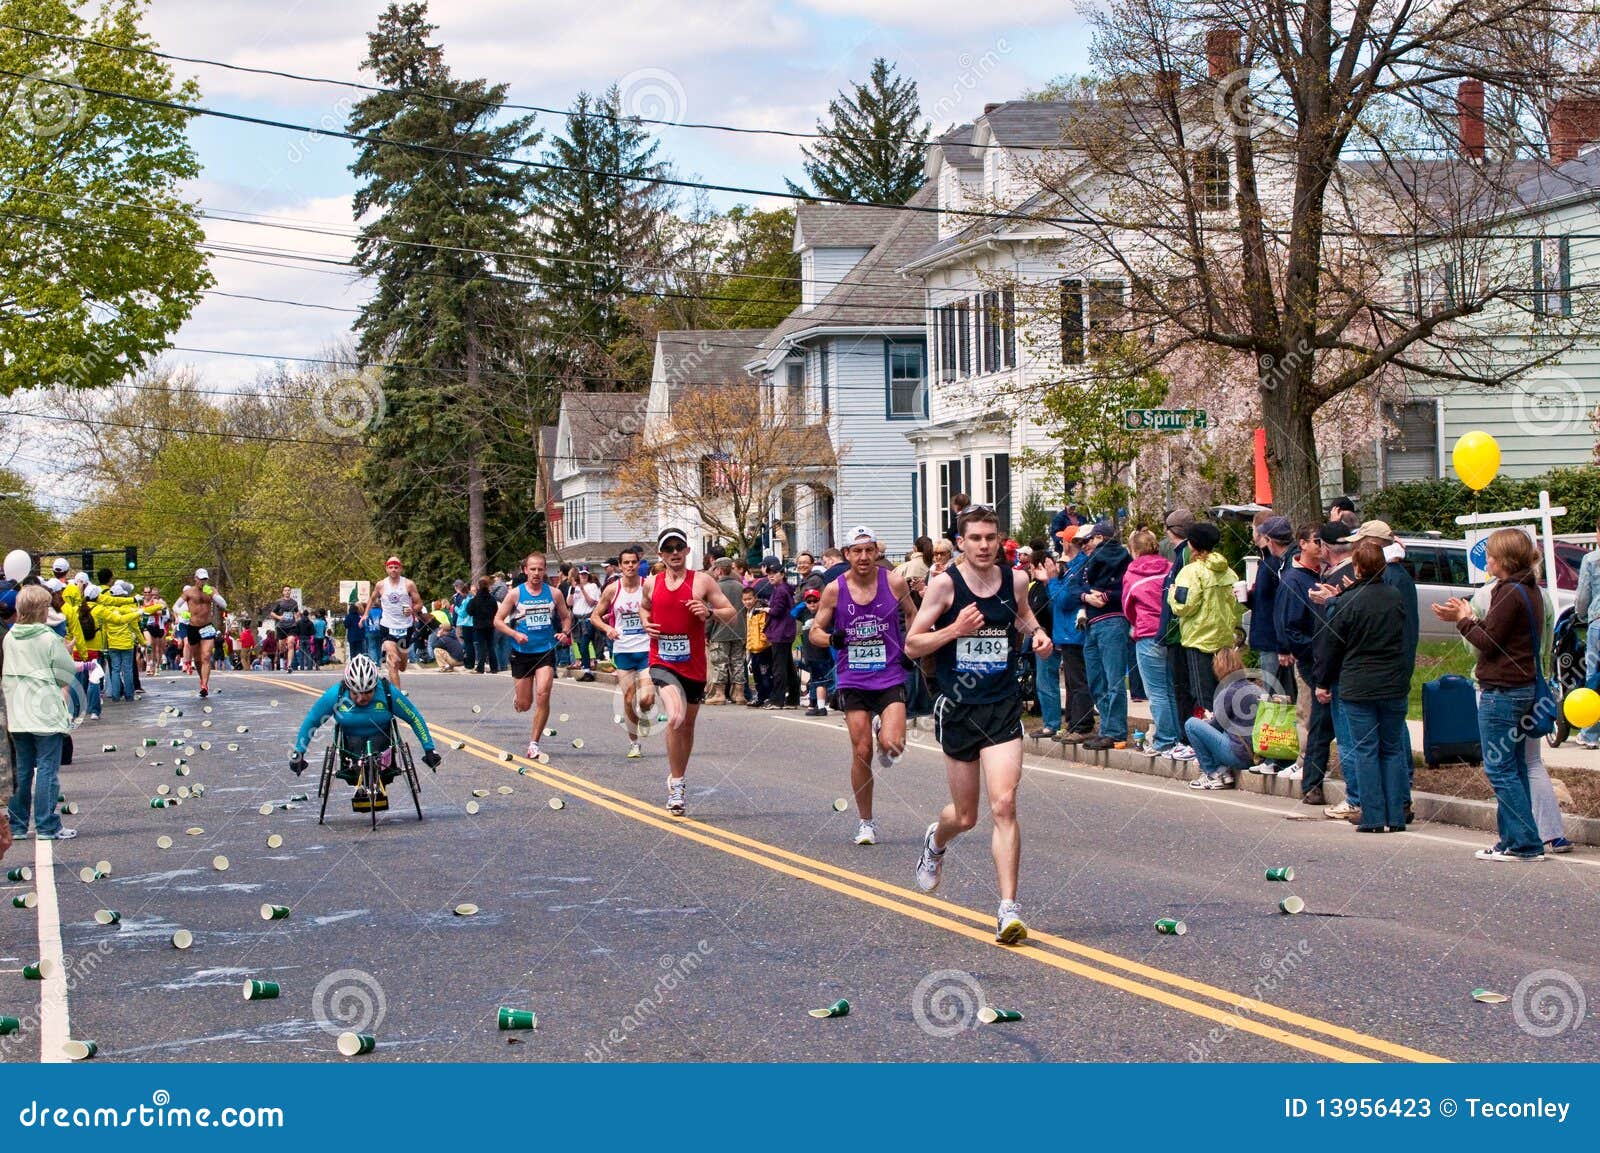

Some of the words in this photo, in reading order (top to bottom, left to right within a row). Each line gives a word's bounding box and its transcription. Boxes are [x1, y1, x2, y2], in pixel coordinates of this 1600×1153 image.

[530, 614, 548, 623] 1062
[979, 628, 1007, 636] adidas
[662, 641, 686, 651] 1255
[965, 640, 1003, 655] 1439
[854, 648, 881, 658] 1243
